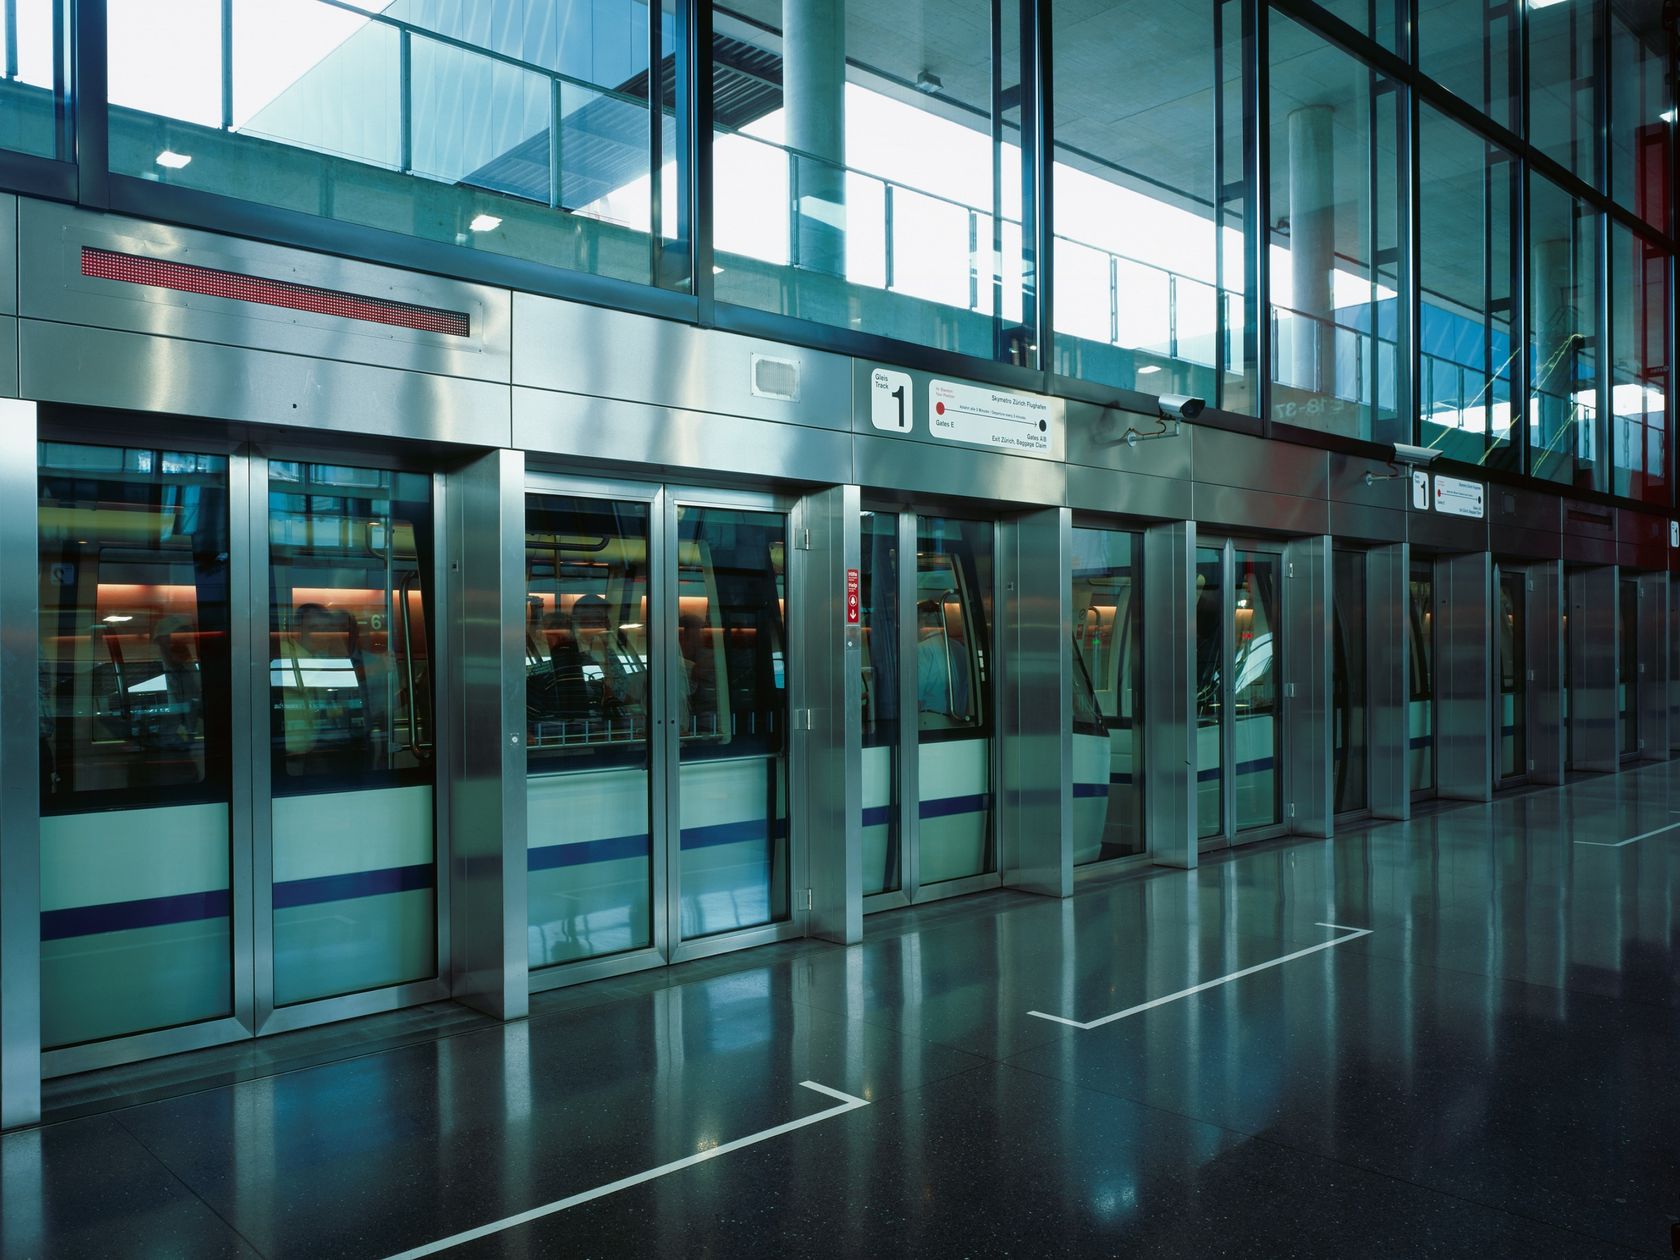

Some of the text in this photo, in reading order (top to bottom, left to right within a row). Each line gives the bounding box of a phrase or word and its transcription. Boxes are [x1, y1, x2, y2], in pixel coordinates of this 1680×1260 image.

[875, 373, 888, 382] Gleis
[875, 381, 889, 389] Track
[892, 385, 904, 427] 1
[991, 394, 1047, 411] Skymetro Zürich Flughafen
[935, 419, 950, 428] Gates
[991, 435, 1001, 443] Exit
[1016, 438, 1035, 448] Baggage
[1026, 433, 1039, 441] Gates
[1420, 480, 1426, 506] 1
